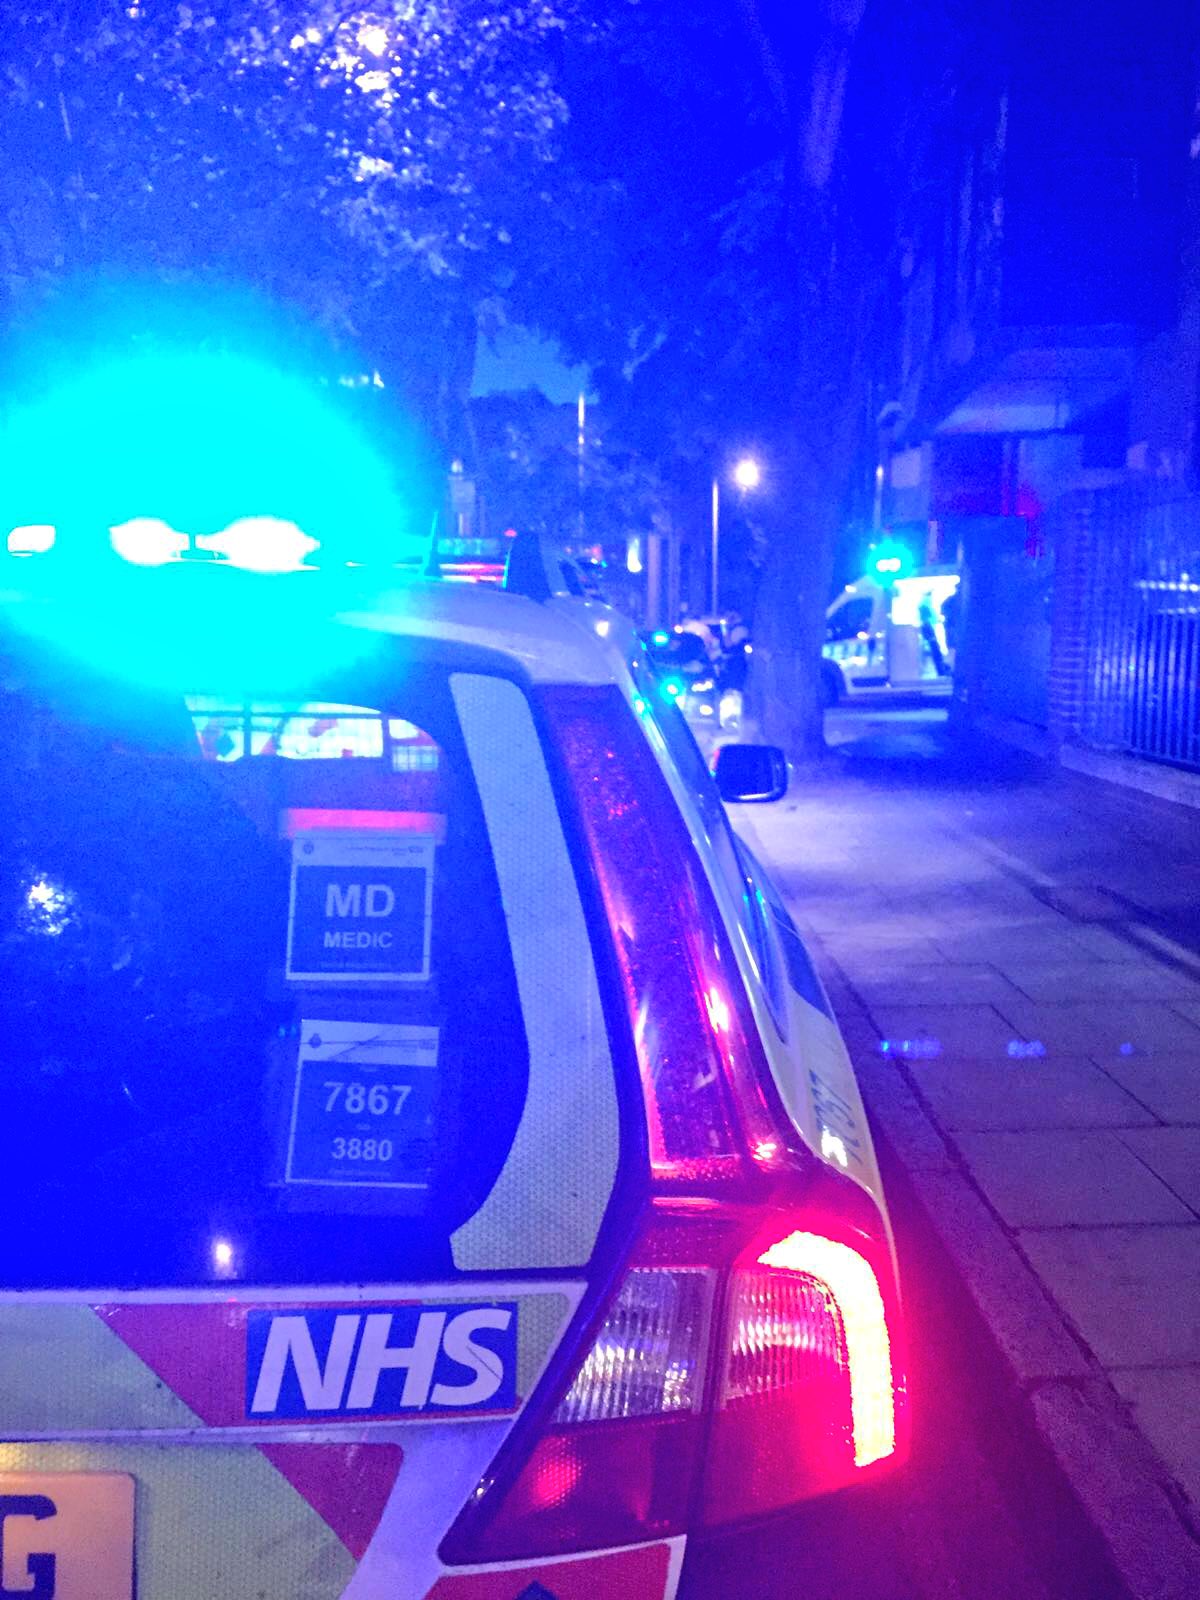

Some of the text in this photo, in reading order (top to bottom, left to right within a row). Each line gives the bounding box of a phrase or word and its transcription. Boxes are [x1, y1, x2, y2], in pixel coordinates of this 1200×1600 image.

[325, 884, 396, 918] MD
[323, 931, 394, 949] MEDIC
[323, 1081, 413, 1116] 7867
[330, 1137, 393, 1161] 3880
[250, 1308, 512, 1414] NHS
